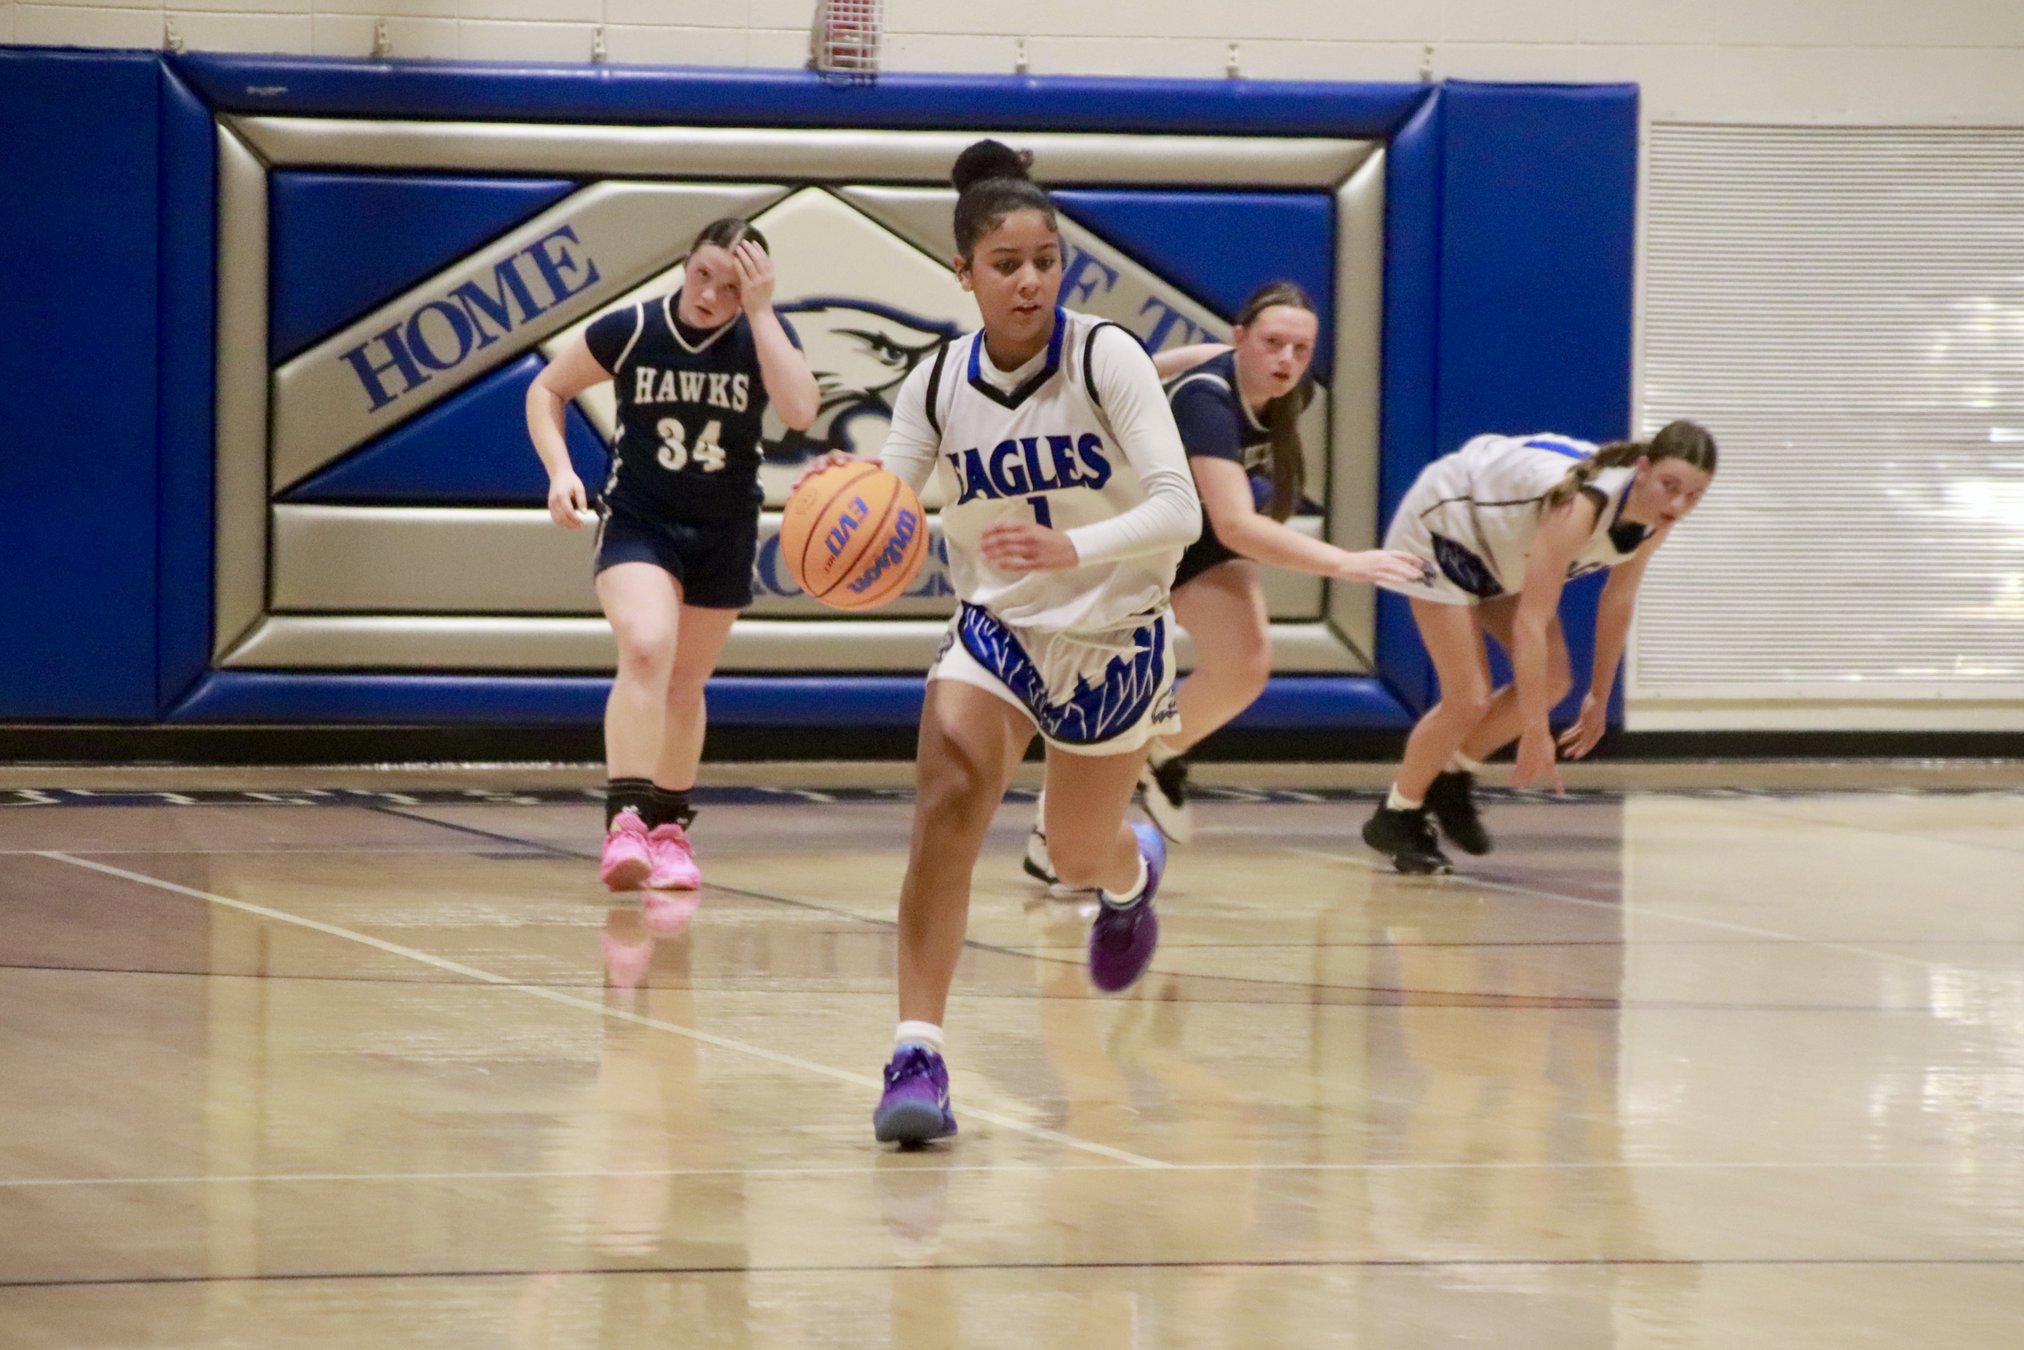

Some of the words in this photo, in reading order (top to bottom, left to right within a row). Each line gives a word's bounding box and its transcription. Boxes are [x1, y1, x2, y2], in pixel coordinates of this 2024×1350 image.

[338, 224, 600, 414] HOME
[634, 366, 750, 413] HAWKS
[656, 417, 727, 472] 34
[847, 508, 918, 594] Wilson
